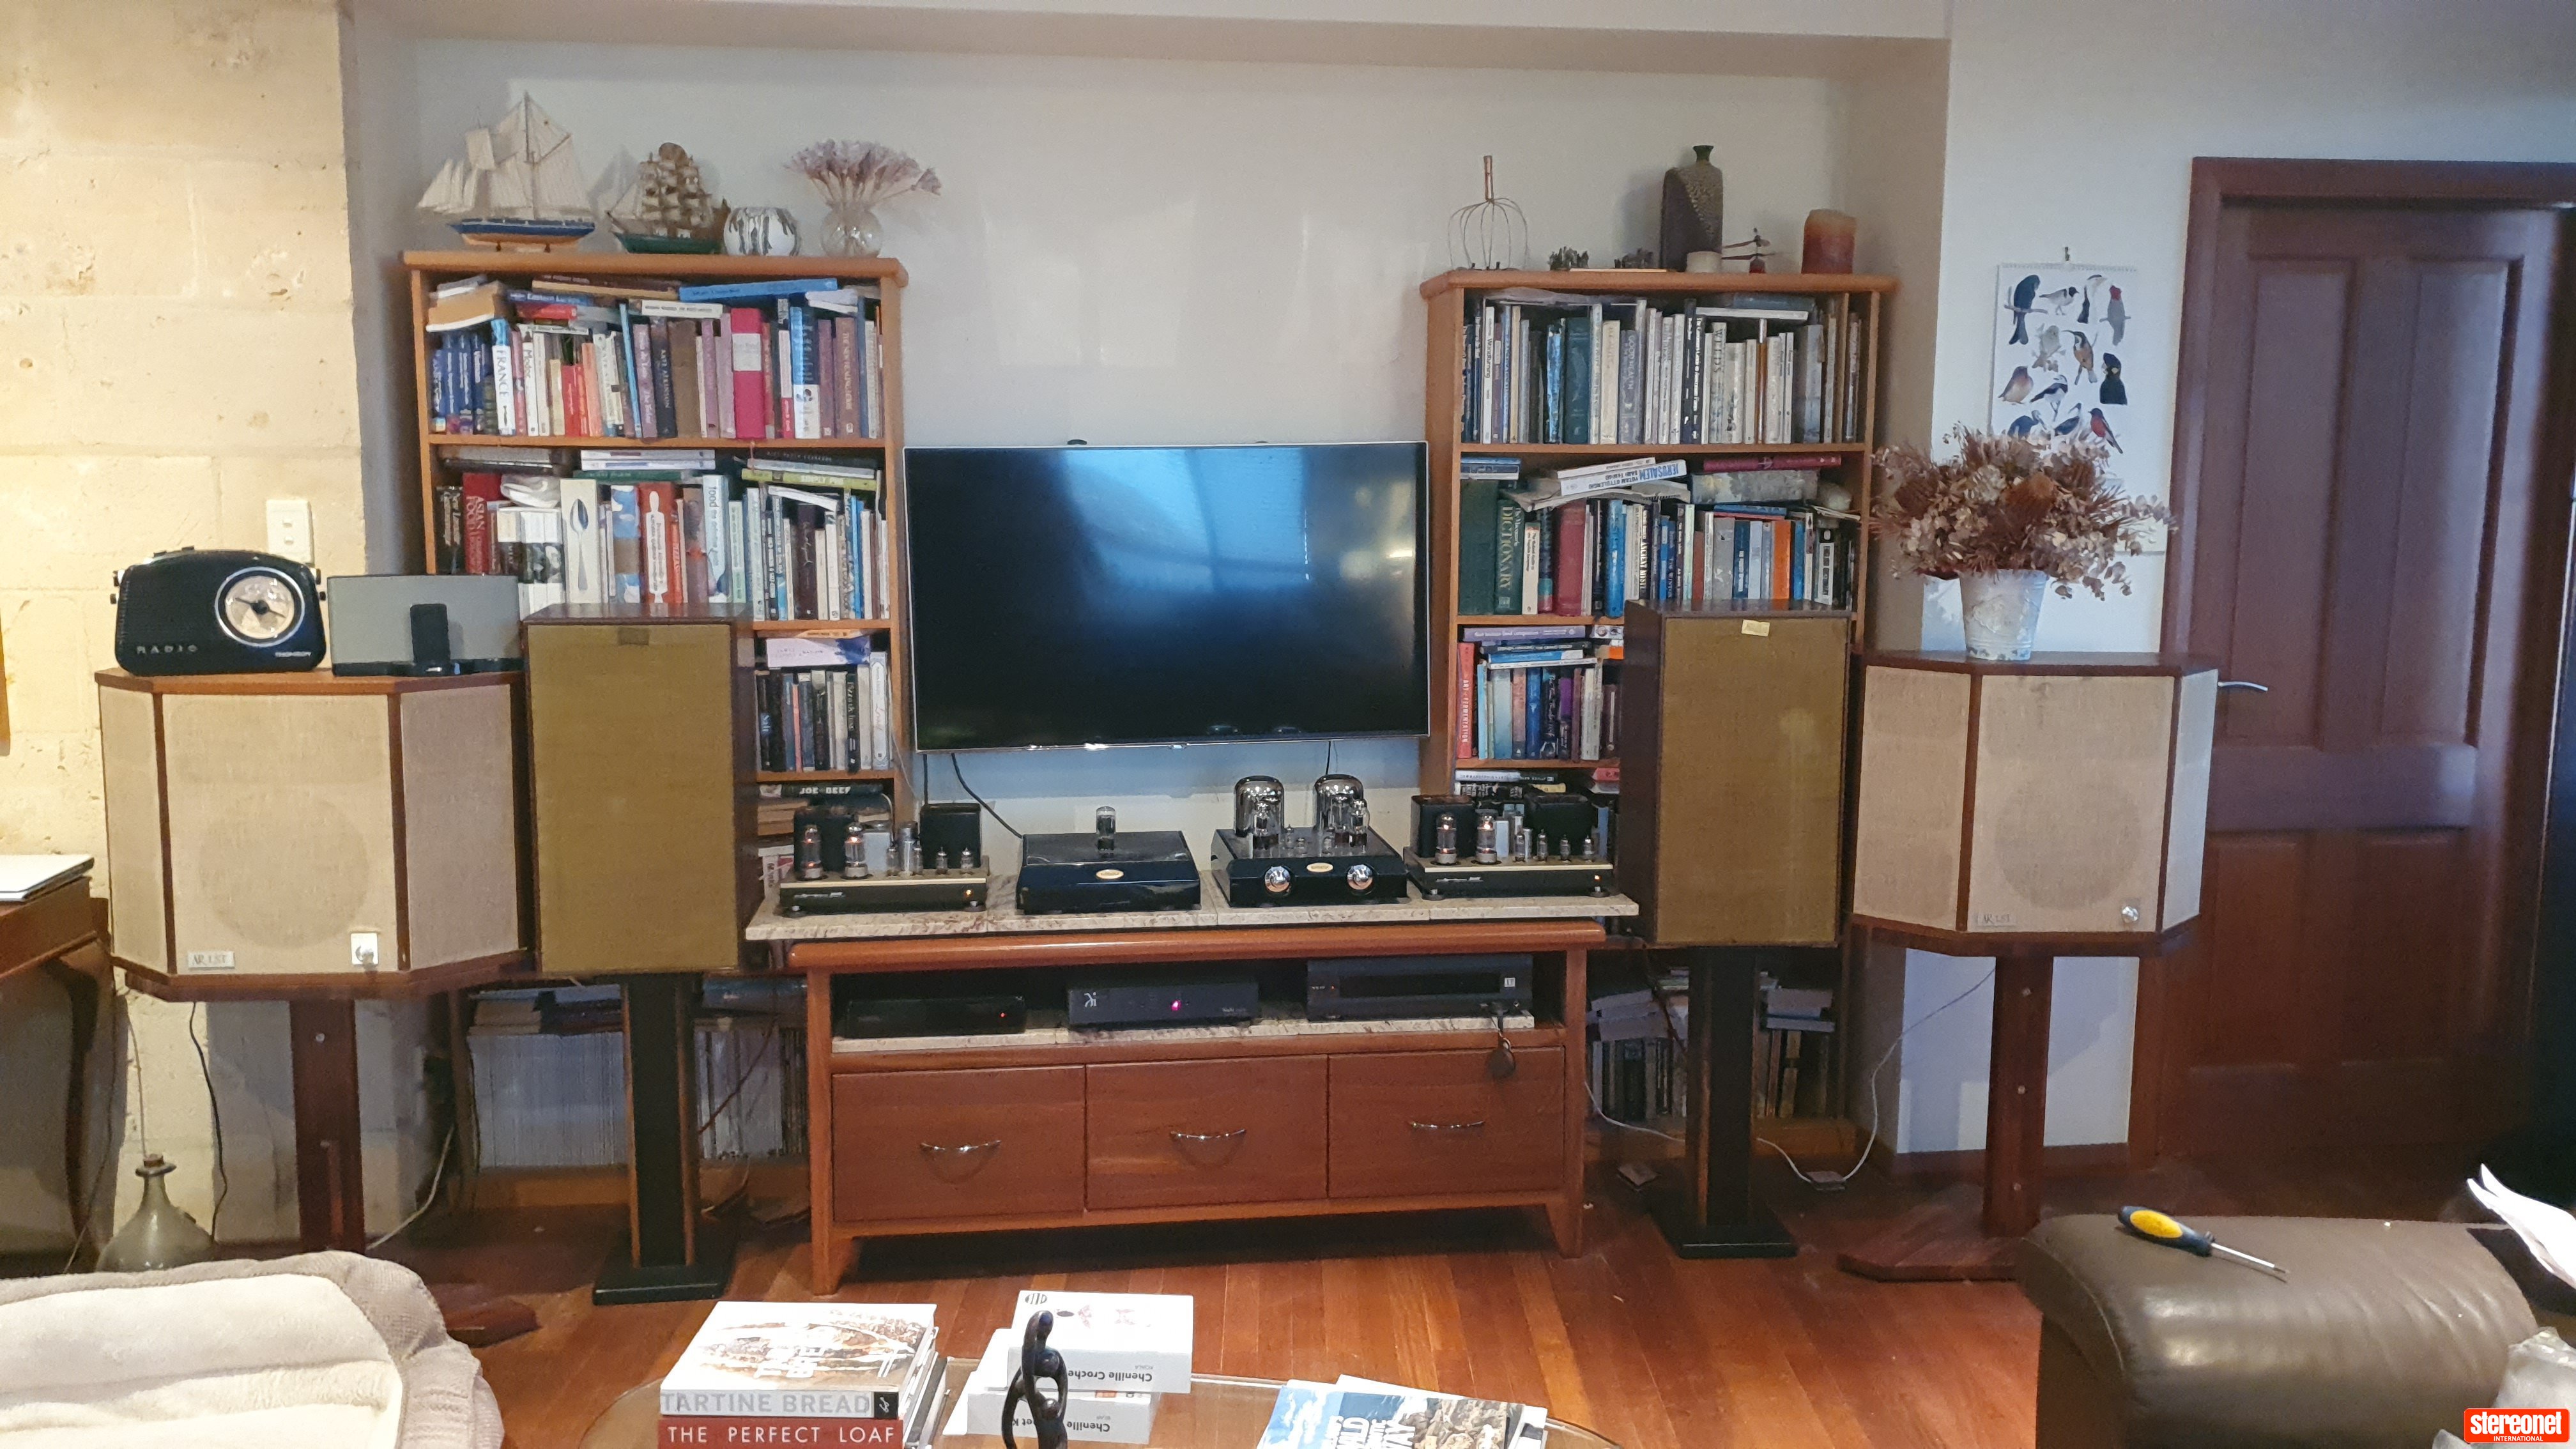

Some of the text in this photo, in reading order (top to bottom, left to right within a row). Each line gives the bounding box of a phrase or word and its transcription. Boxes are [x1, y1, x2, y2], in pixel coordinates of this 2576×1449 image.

[496, 350, 509, 396] FRANCE
[663, 370, 671, 409] ATKINSON
[1639, 463, 1679, 481] JERUSALEM
[709, 486, 719, 508] food
[475, 496, 485, 531] ASIAN
[1499, 507, 1514, 590] DICTIONARY
[136, 645, 199, 654] RADIO
[799, 786, 851, 795] JOE BEEF
[1068, 1370, 1153, 1383] Chenille Croche
[661, 1393, 871, 1414] TARTINE BREAD
[668, 1427, 895, 1443] THE PERFECT LOAF
[1066, 1421, 1111, 1432] Chenille
